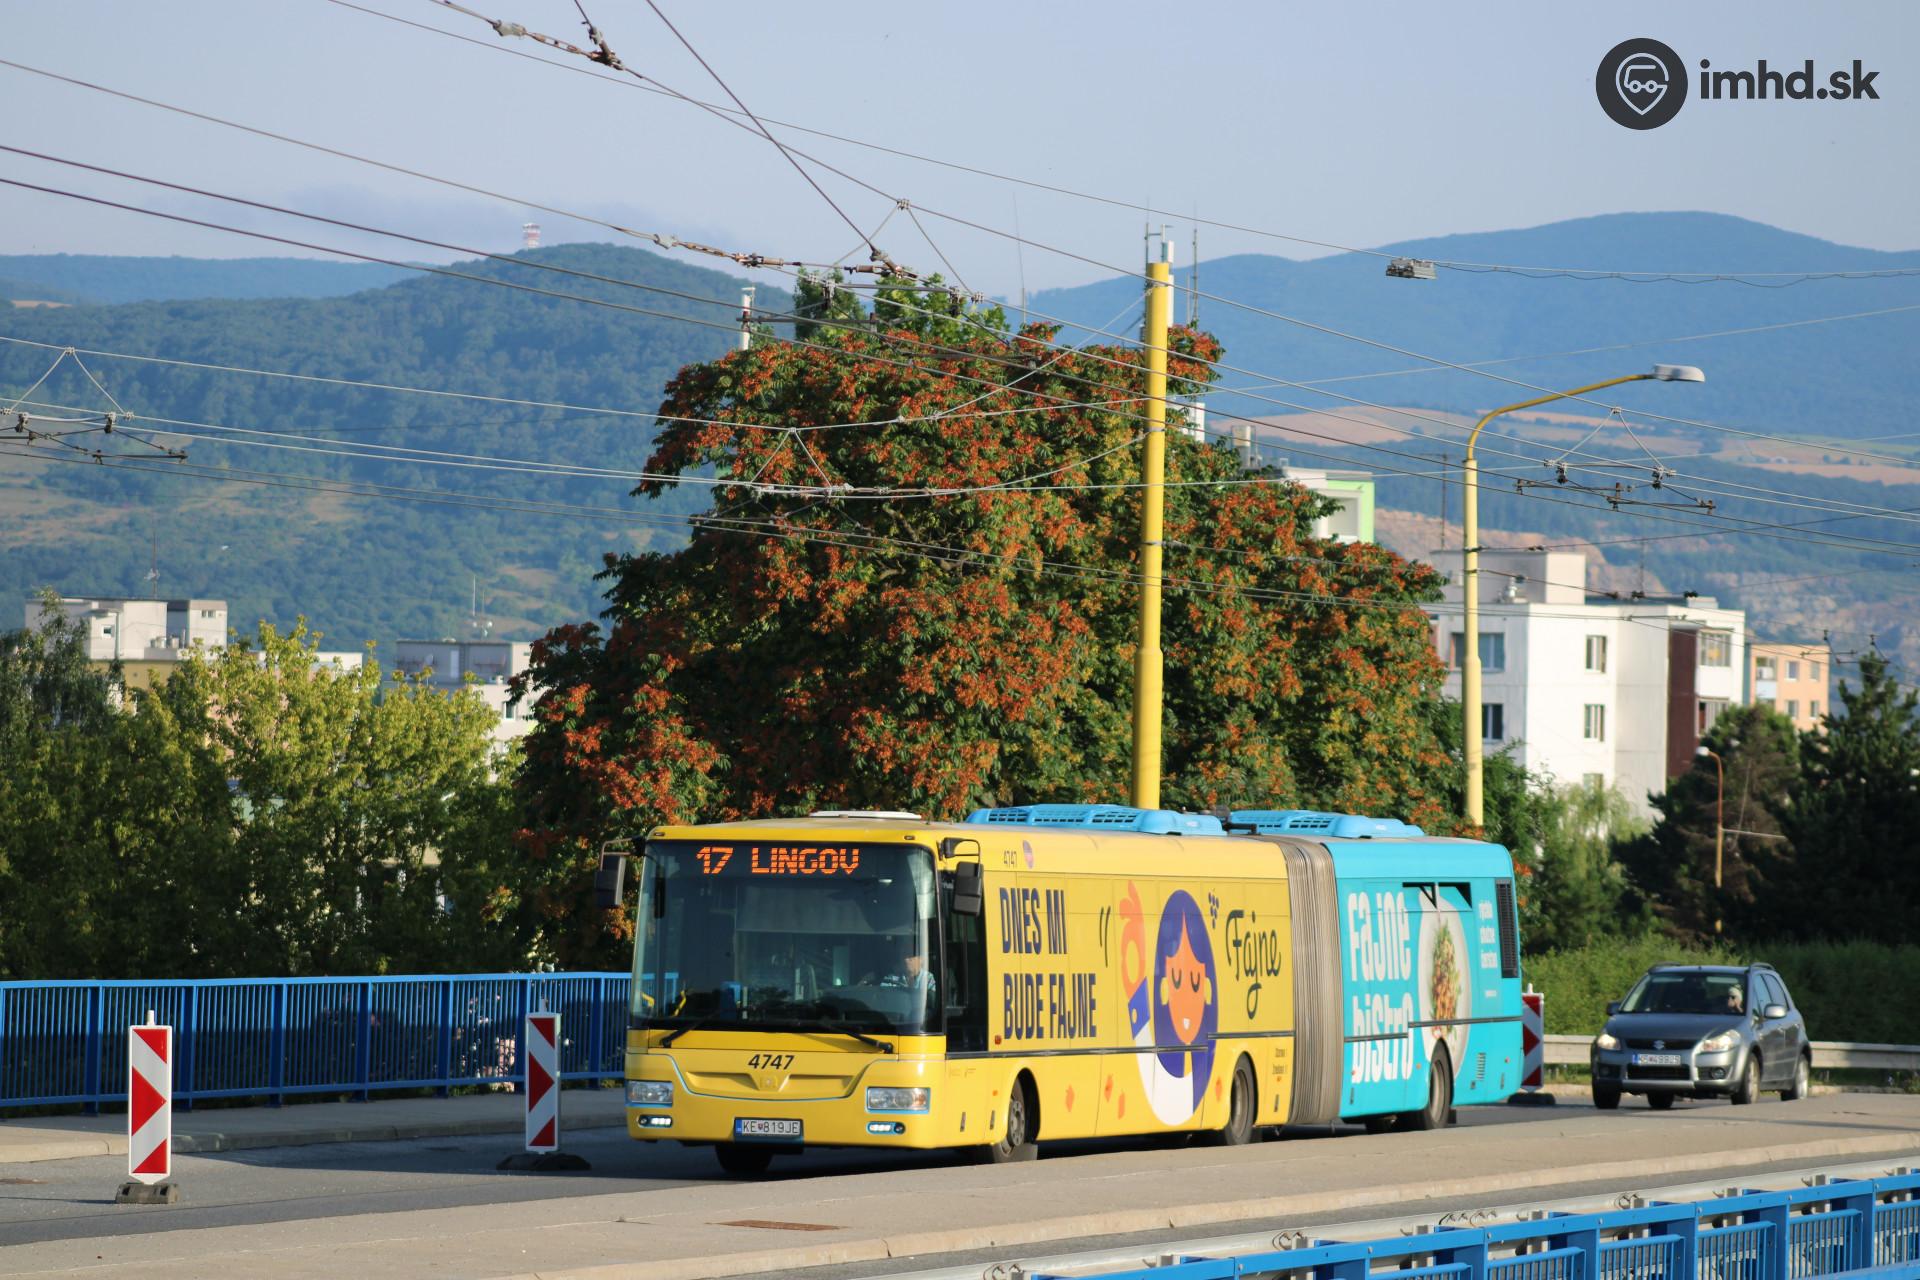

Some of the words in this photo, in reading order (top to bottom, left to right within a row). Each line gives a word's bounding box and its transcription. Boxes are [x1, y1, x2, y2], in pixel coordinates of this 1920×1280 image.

[696, 847, 734, 874] 17
[752, 848, 860, 874] LINGOV
[999, 887, 1043, 955] DNES
[1045, 888, 1068, 955] MI
[1225, 909, 1282, 1020] Fajne
[1003, 972, 1045, 1040] BUDE
[1048, 972, 1098, 1039] FAJNE
[747, 1053, 795, 1070] 4747
